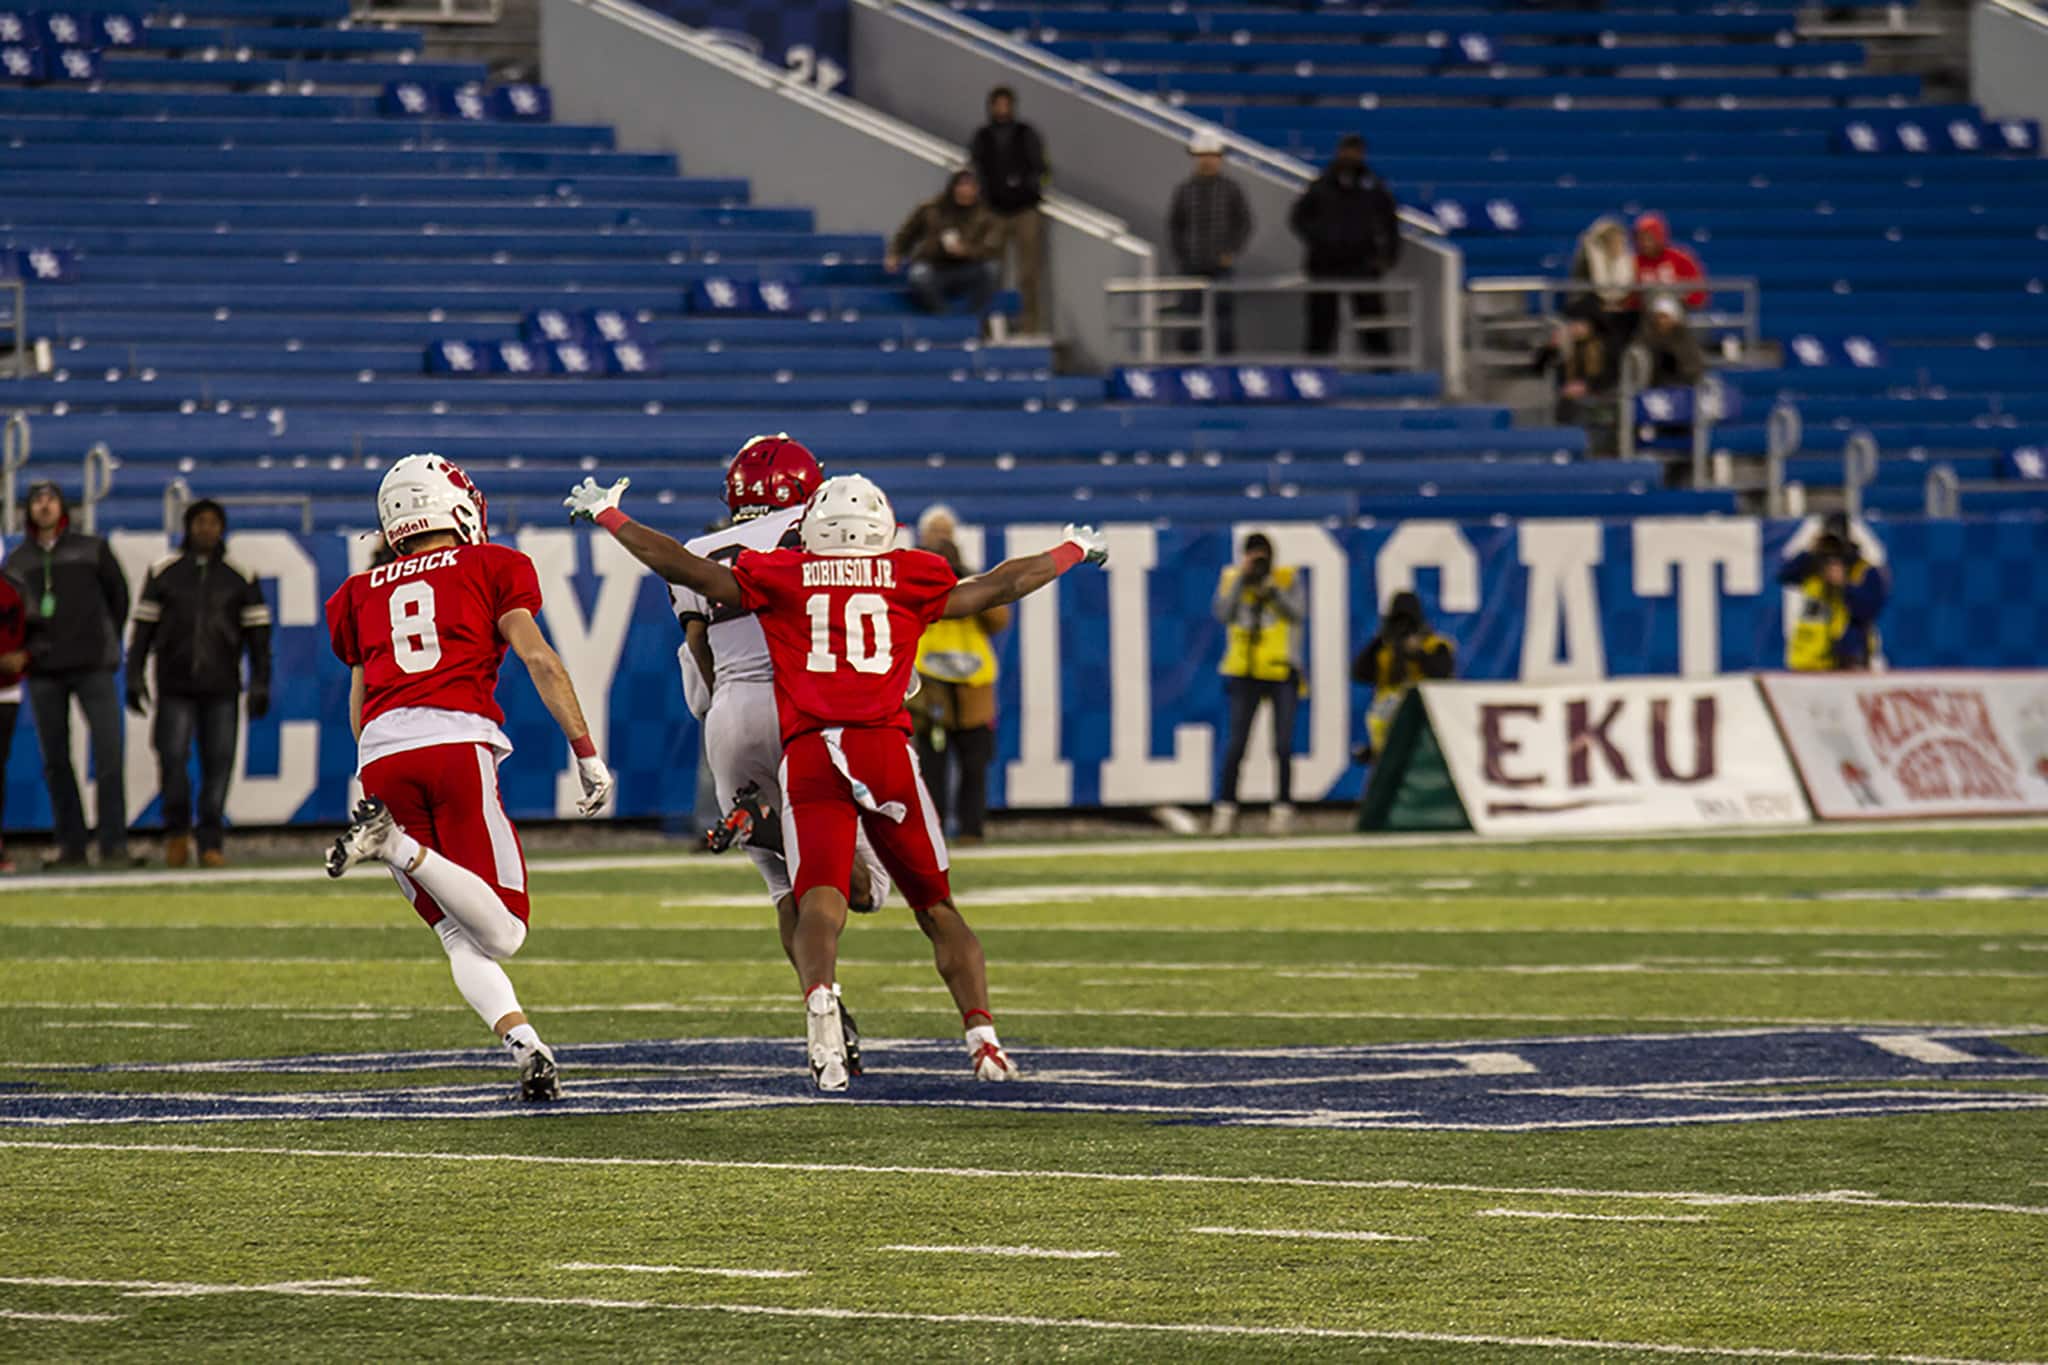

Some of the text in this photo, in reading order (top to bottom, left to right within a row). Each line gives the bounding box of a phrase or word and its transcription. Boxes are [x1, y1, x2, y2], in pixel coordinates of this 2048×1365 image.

[370, 549, 461, 588] CUSICK
[803, 559, 872, 587] ROBINSON
[389, 579, 443, 675] 8
[805, 592, 894, 675] 10
[896, 516, 1886, 803] ILDAT
[1479, 695, 1717, 788] EKU
